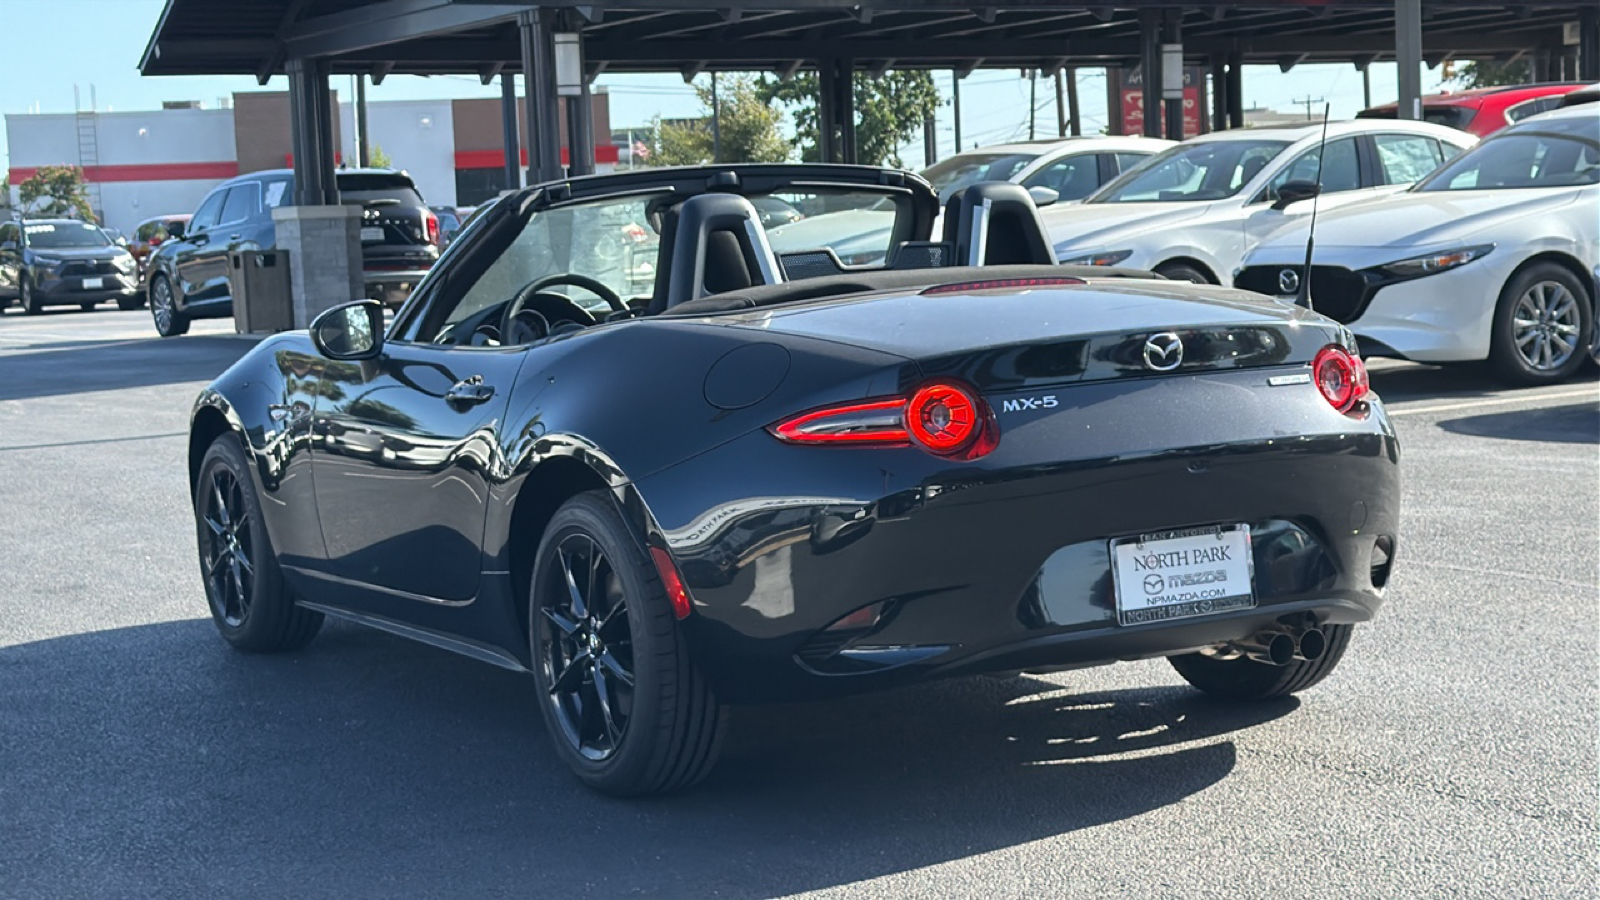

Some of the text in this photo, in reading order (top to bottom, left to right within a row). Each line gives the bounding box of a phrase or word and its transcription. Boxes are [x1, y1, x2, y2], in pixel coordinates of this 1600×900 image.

[1003, 395, 1060, 413] MX-5
[1134, 545, 1232, 571] NORTH PARK
[1168, 569, 1227, 589] mazda
[1146, 588, 1226, 605] NPMAZDA.COM
[1127, 608, 1166, 623] NORTH
